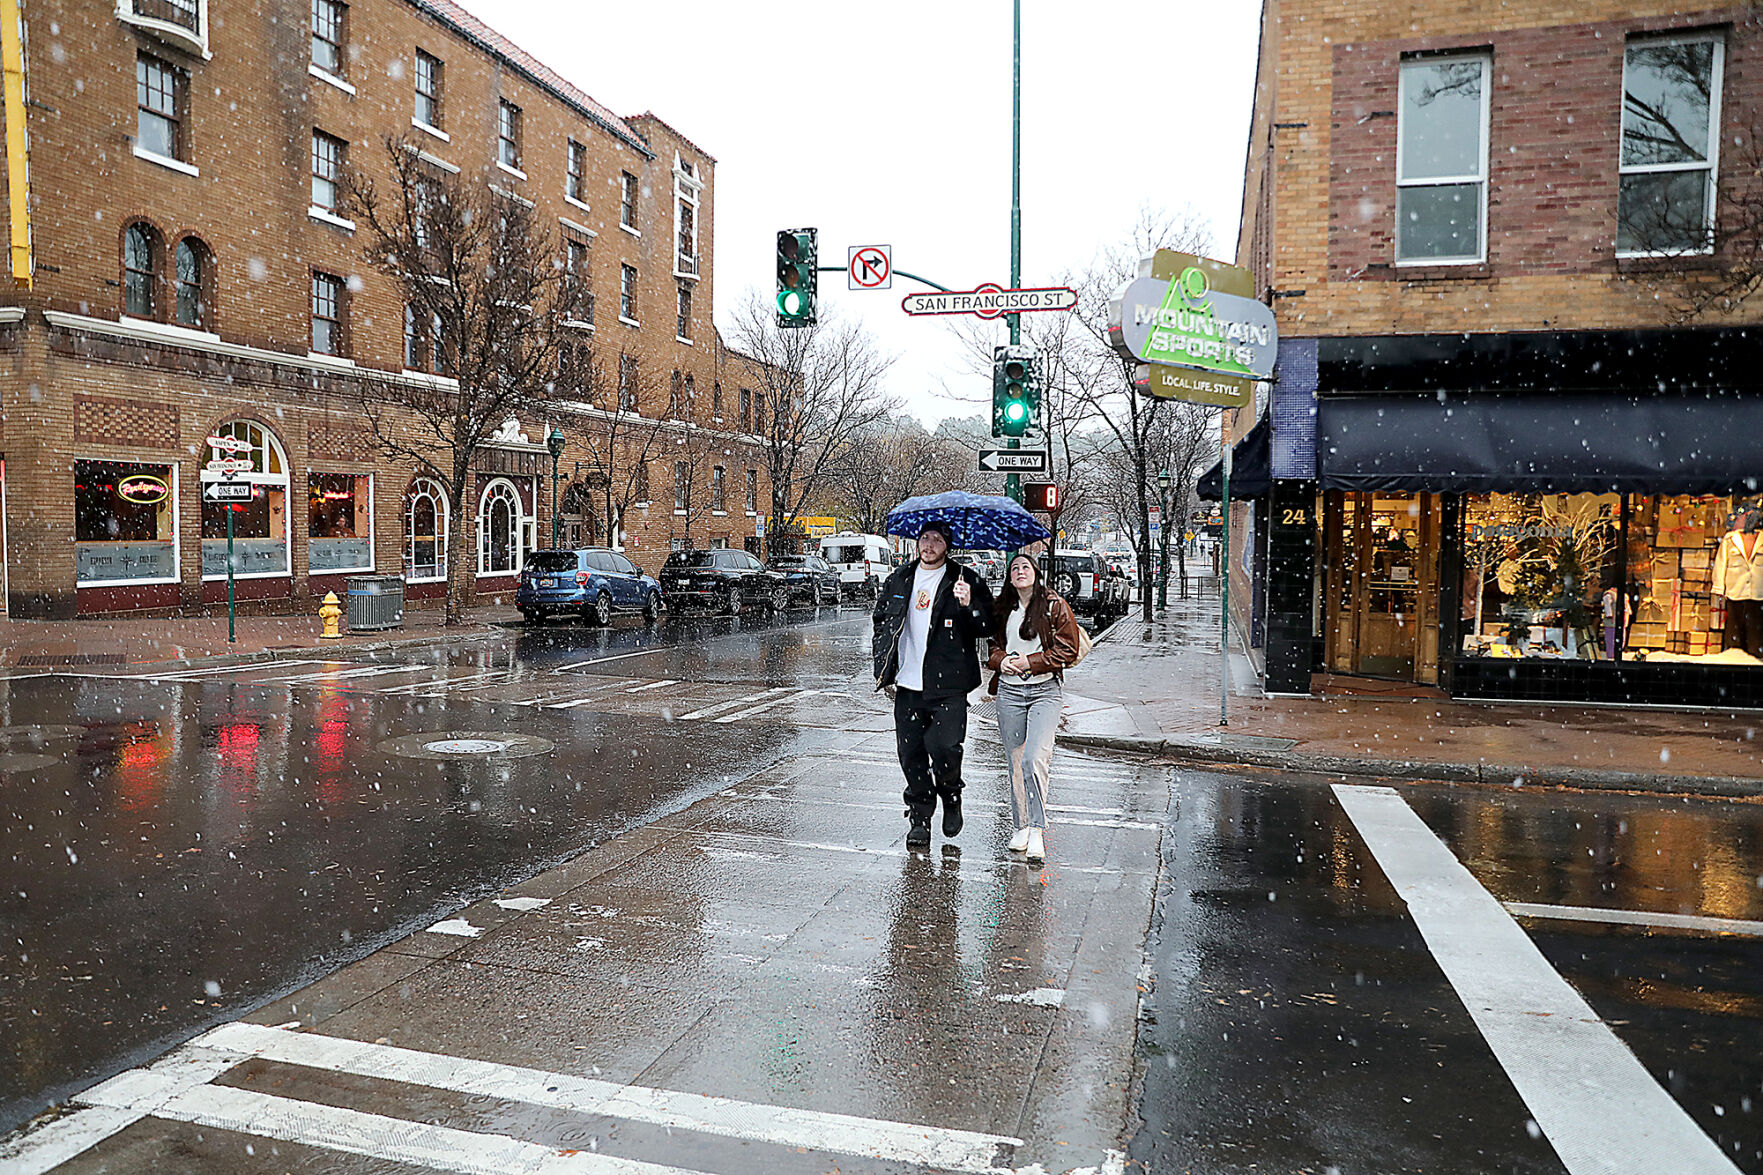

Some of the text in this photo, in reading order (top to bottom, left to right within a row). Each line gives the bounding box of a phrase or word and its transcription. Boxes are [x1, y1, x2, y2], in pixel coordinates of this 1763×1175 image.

[915, 293, 1064, 312] SAN FRANCISCO ST
[1134, 303, 1271, 347] MOUNTAIN
[1151, 331, 1257, 366] SPORTS
[998, 456, 1040, 466] ONE WAY
[218, 487, 247, 495] ONE WAY
[1046, 487, 1056, 508] 8
[1282, 508, 1307, 526] 24
[1471, 523, 1573, 542] patagonia
